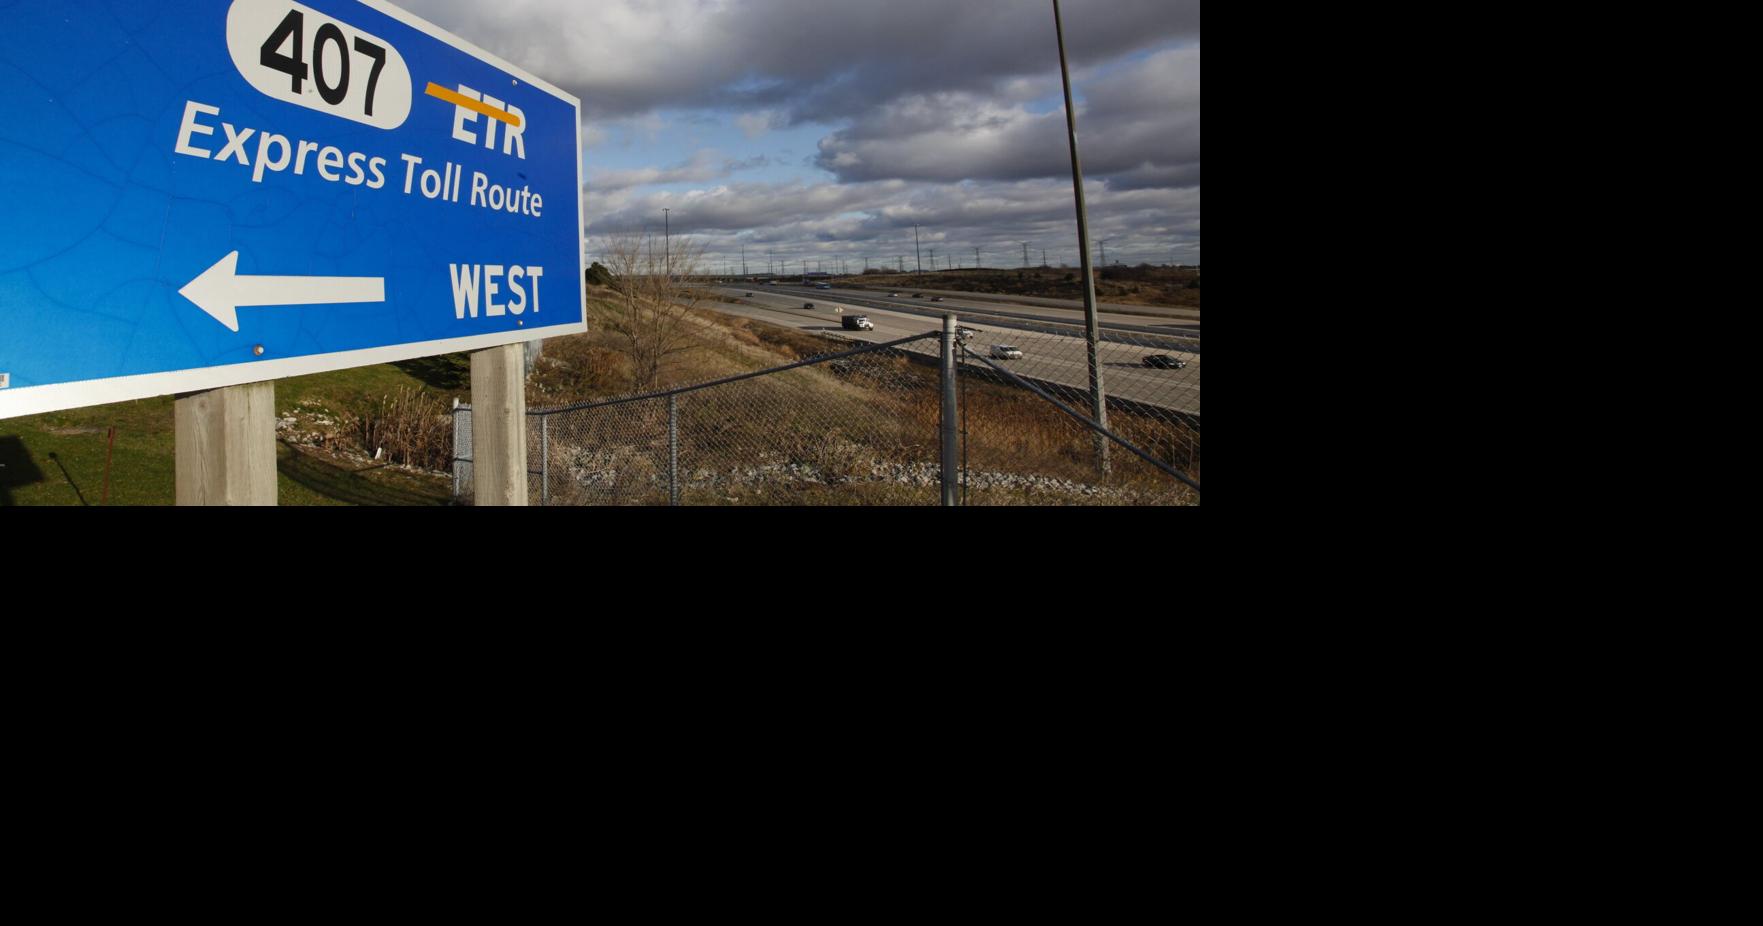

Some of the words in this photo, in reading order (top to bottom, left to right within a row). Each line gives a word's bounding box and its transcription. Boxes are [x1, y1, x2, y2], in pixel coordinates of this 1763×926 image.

[260, 8, 386, 117] 407
[174, 100, 386, 189] Express
[401, 153, 462, 202] Toll
[470, 172, 543, 217] Route
[452, 83, 527, 160] ETR
[449, 263, 543, 320] WEST
